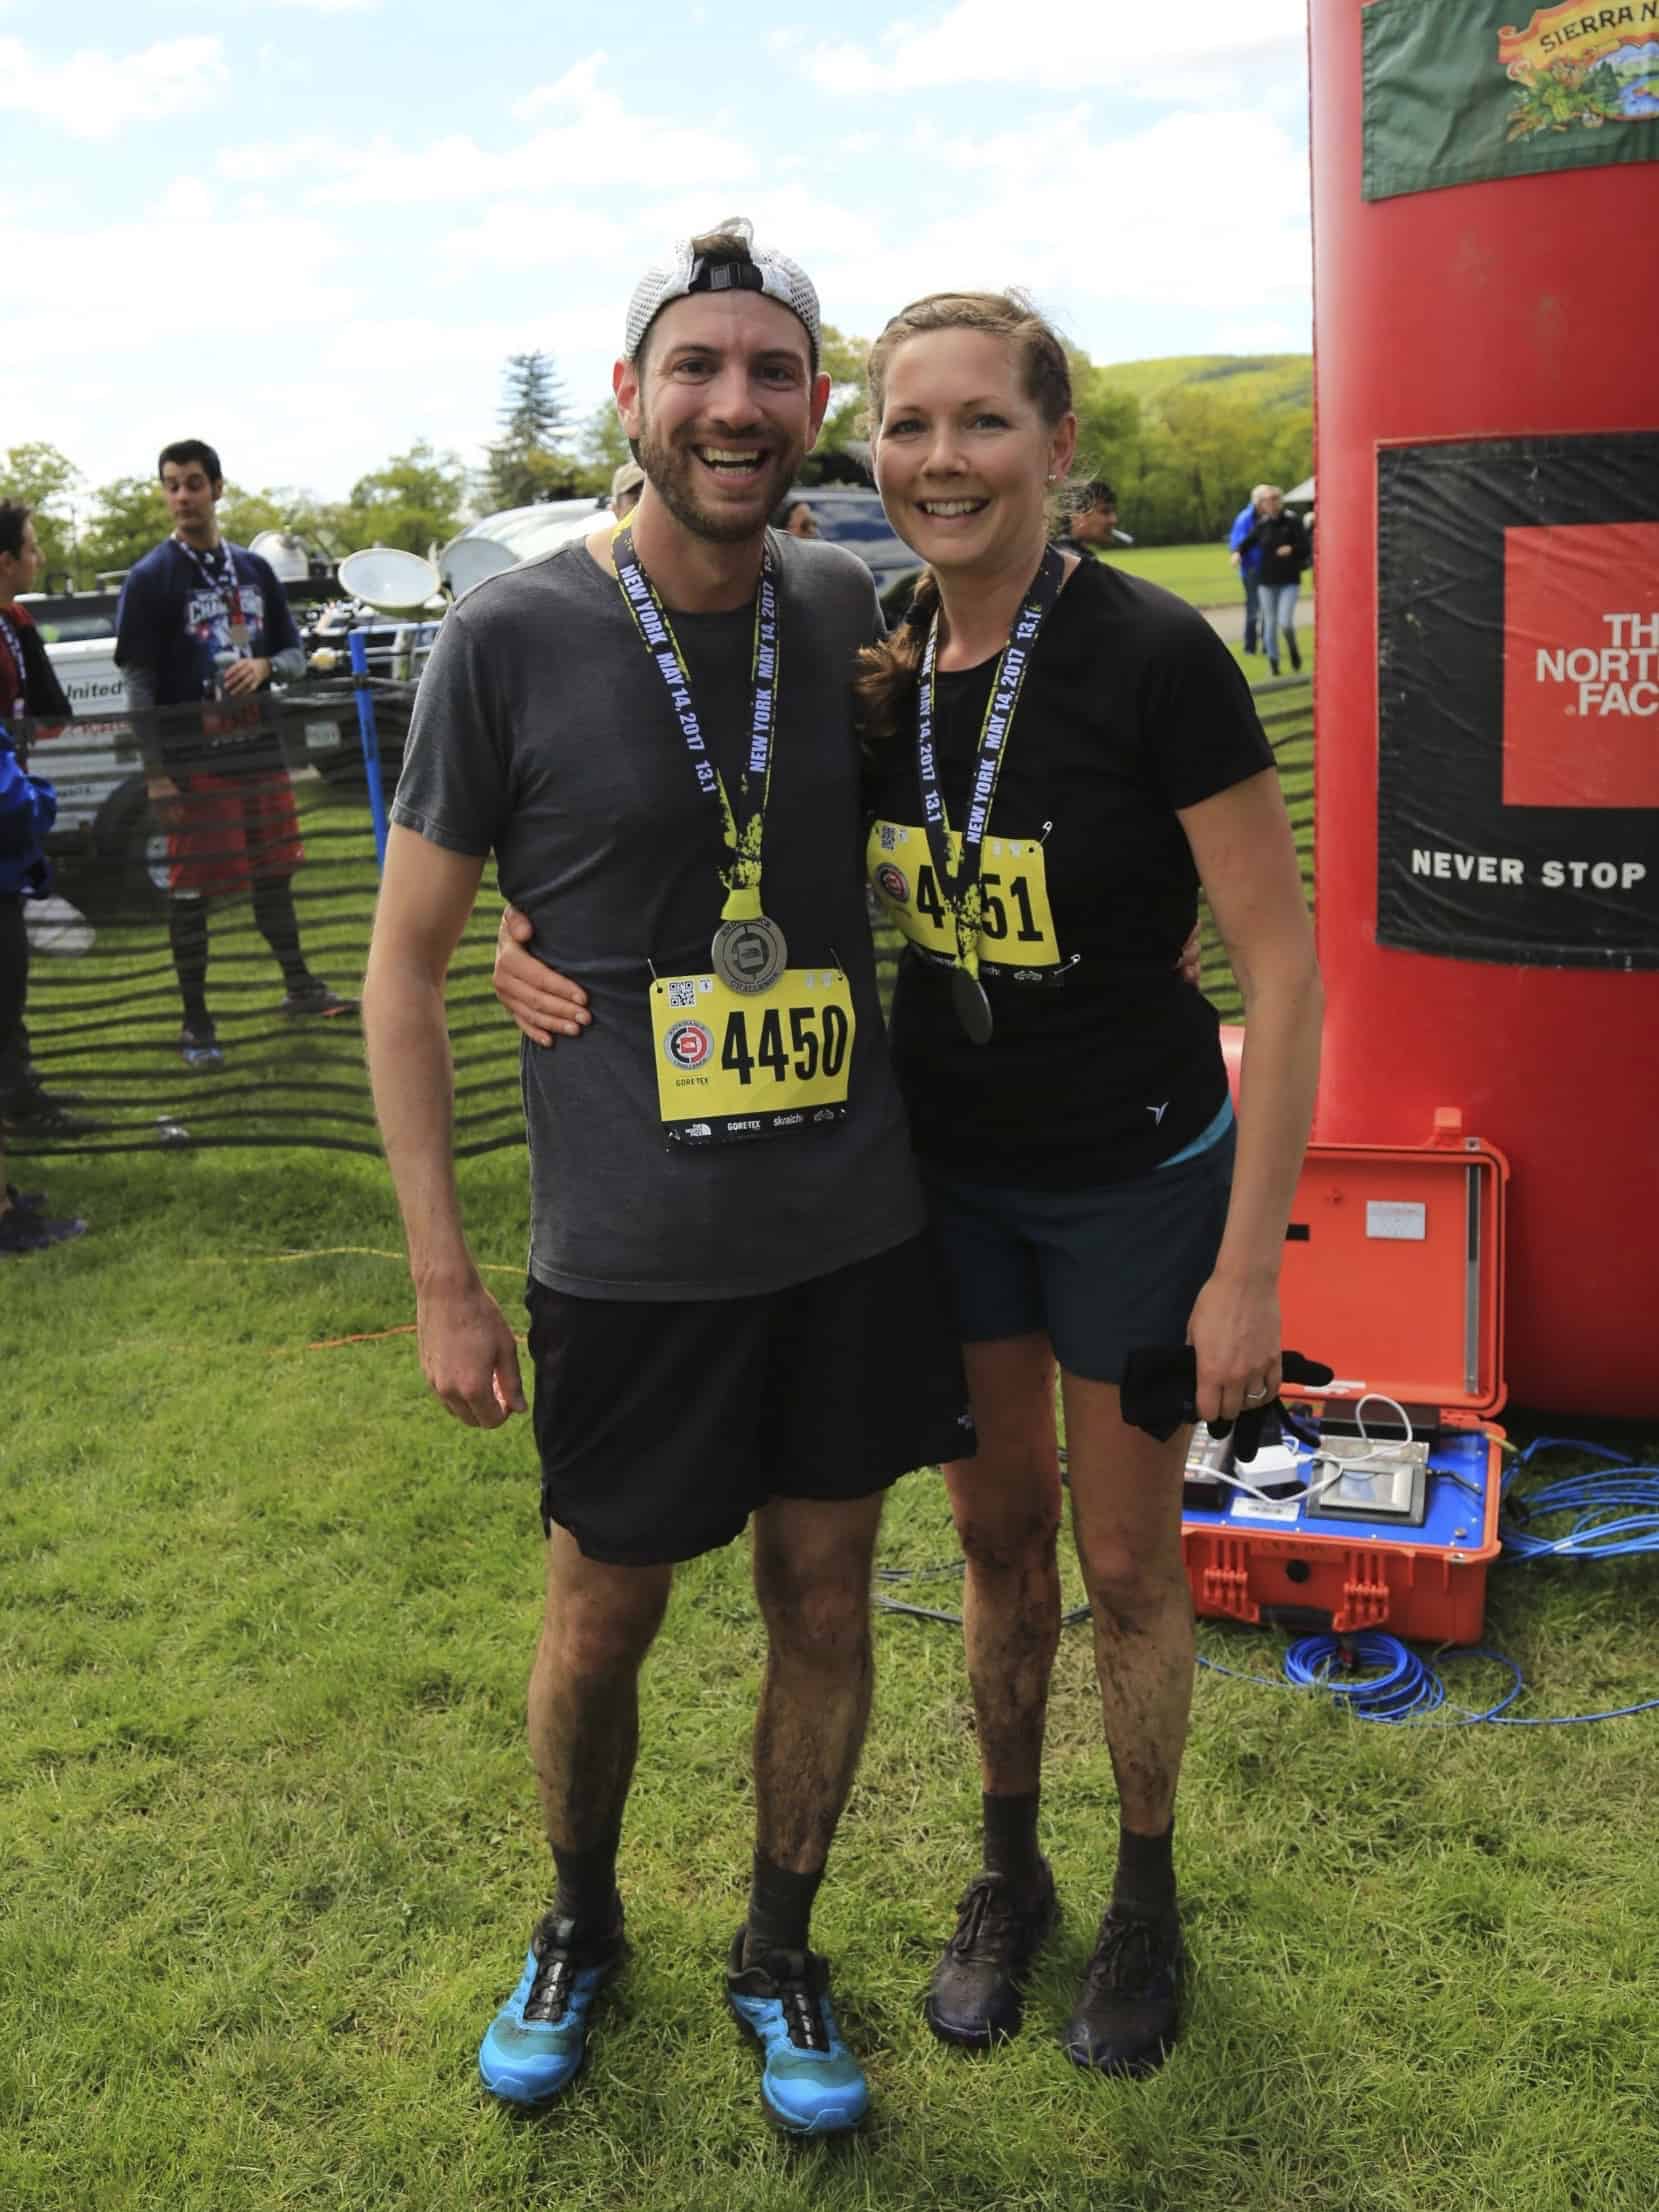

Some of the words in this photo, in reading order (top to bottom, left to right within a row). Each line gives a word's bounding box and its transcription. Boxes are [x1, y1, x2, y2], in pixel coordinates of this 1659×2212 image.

[1540, 6, 1634, 54] SIERRA
[619, 563, 650, 602] NEW
[761, 581, 776, 619] 2017
[636, 599, 668, 645] YORK
[760, 622, 776, 643] 14,
[1016, 609, 1042, 640] 13.1
[1603, 612, 1659, 648] TH
[656, 651, 685, 685] MAY
[758, 646, 776, 680] MAY
[1001, 647, 1026, 687] 2017
[1536, 647, 1659, 683] NORT
[671, 686, 692, 712] 14,
[754, 687, 773, 728] YORK
[919, 684, 932, 717] MAY
[995, 688, 1016, 713] 14,
[1579, 681, 1659, 717] FAC
[679, 712, 705, 751] 2017
[749, 728, 769, 773] NEW
[985, 714, 1006, 750] MAY
[695, 759, 717, 793] 13.1
[920, 743, 936, 781] 2017
[975, 759, 997, 801] YORK
[924, 792, 942, 823] 13.1
[966, 800, 987, 844] NEW
[1411, 849, 1525, 885] NEVER
[1541, 861, 1647, 889] STOP
[915, 864, 1044, 942] 451
[721, 1004, 849, 1086] 4450
